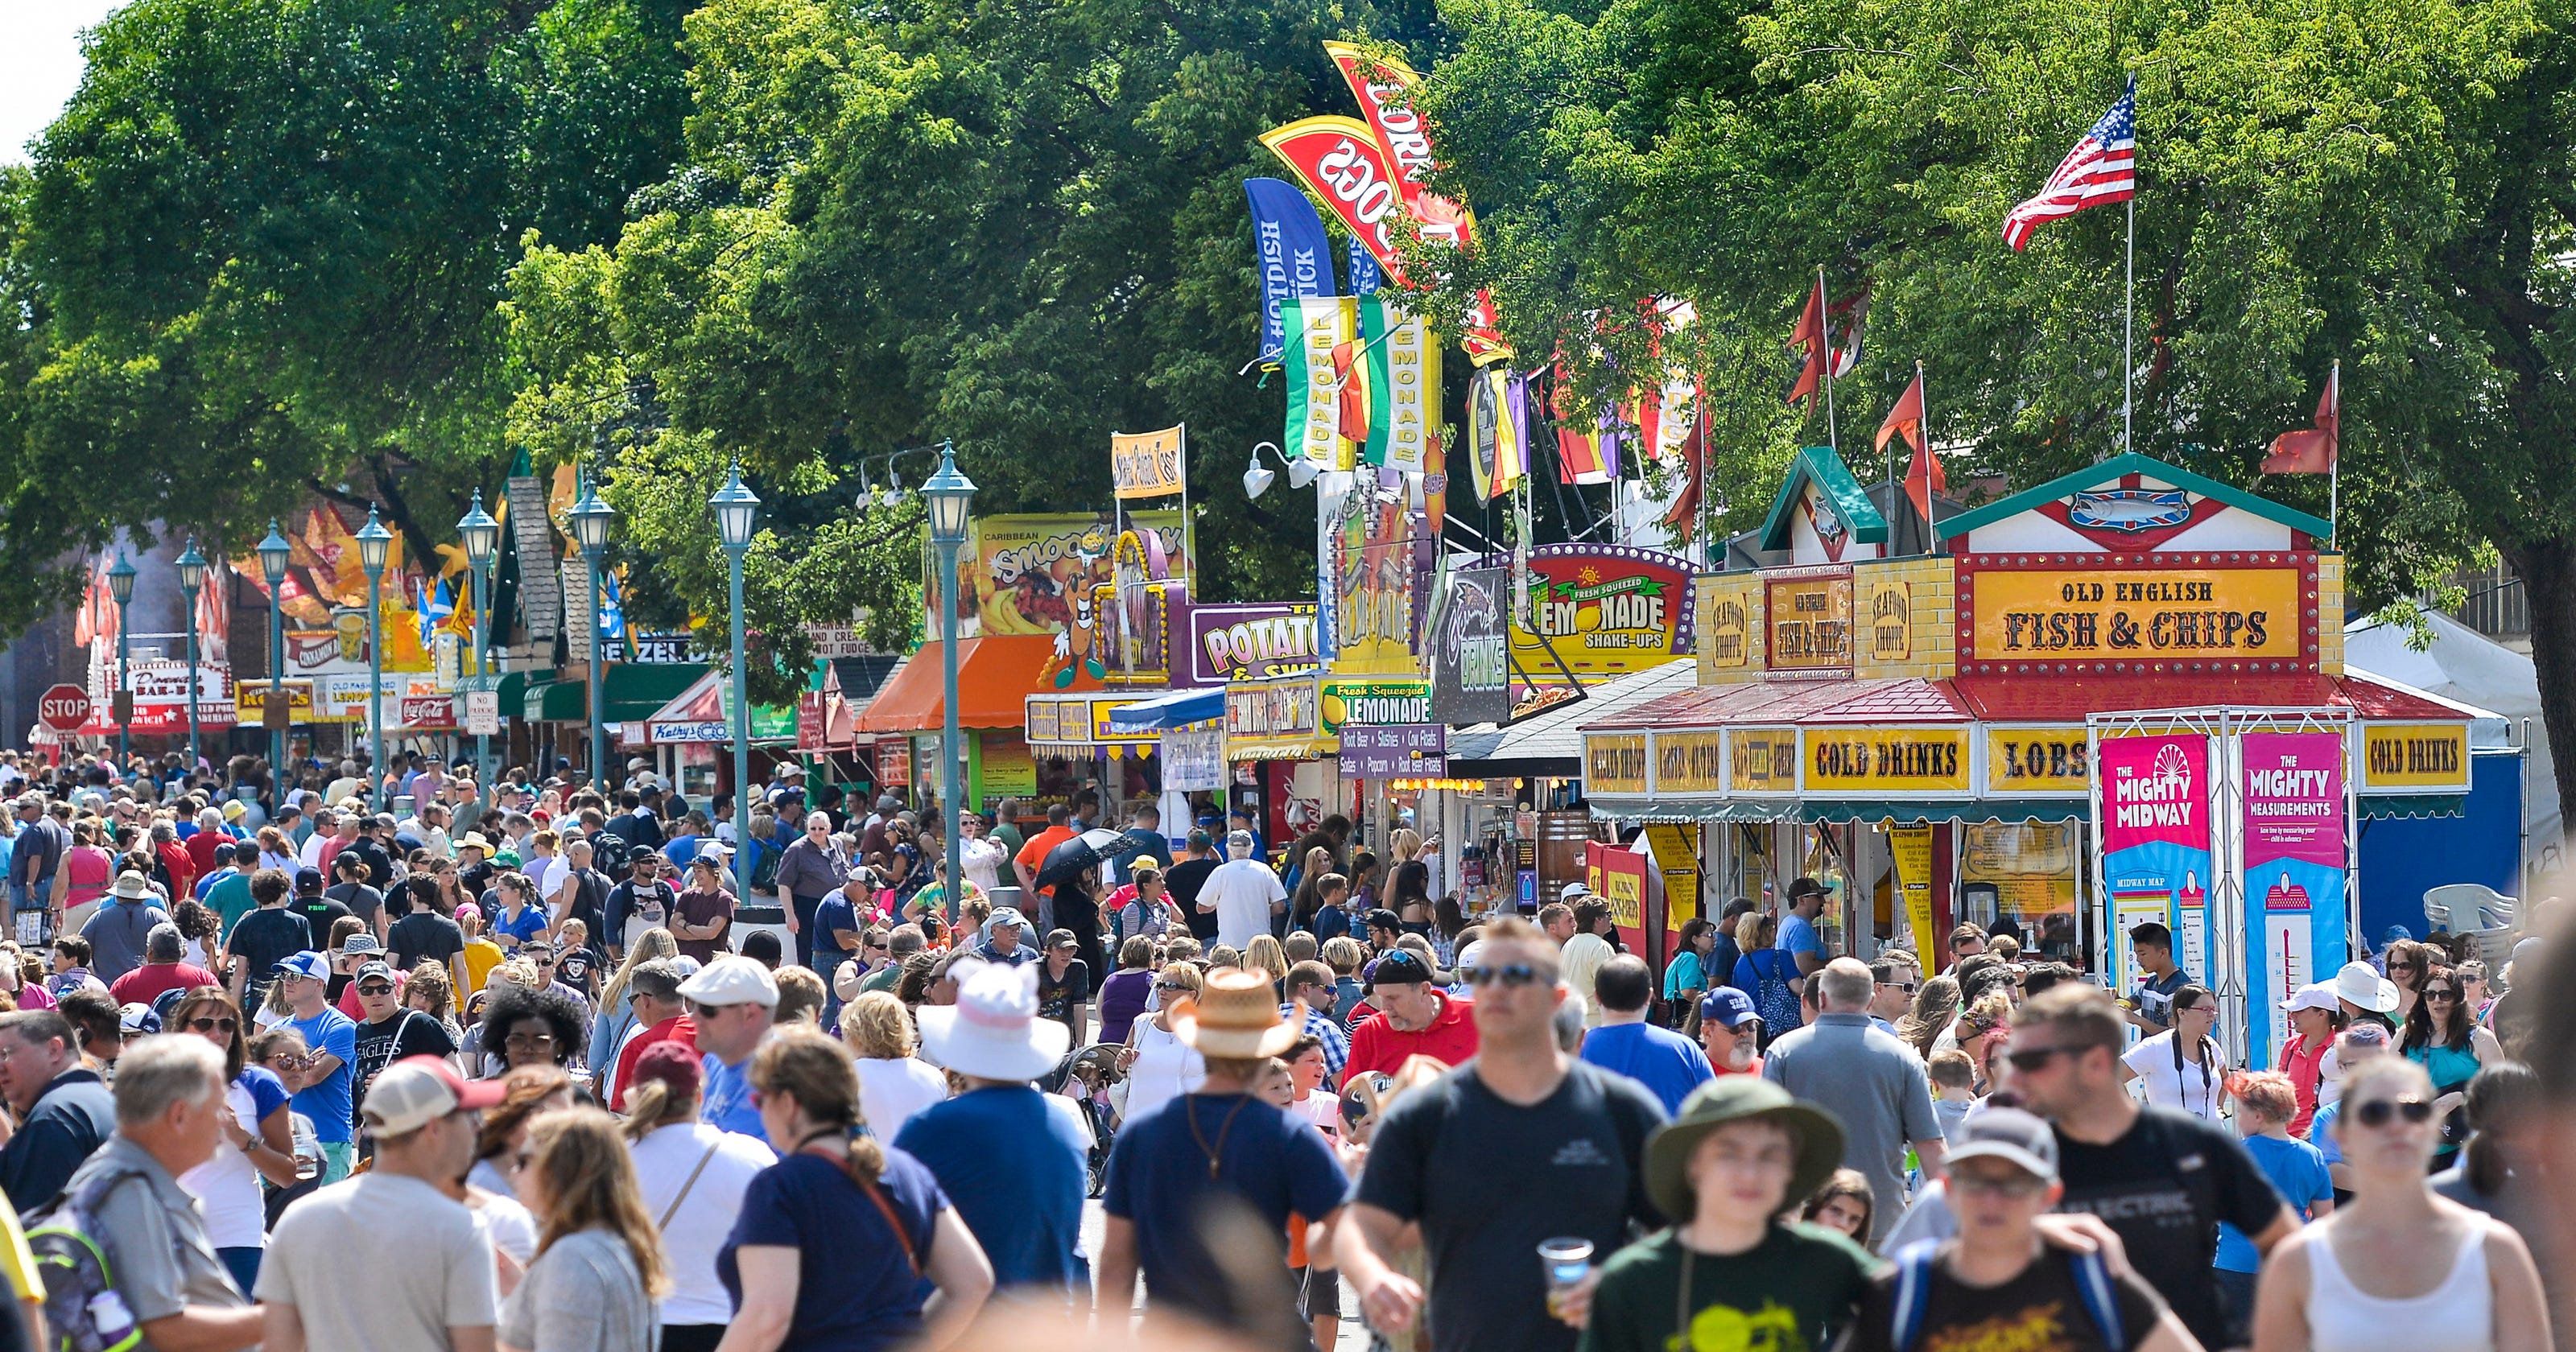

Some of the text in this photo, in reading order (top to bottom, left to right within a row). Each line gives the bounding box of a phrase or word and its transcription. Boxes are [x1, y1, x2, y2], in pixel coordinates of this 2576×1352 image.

[1294, 246, 1319, 298] TICK
[1308, 317, 1335, 460] LEMONADE
[1393, 311, 1418, 463] LEMONADE
[985, 532, 1038, 541] CARIBBEAN
[1575, 578, 1643, 600] FRESH SQUEEZED
[2062, 582, 2213, 603] OLD ENGLISH
[1713, 600, 1745, 634] SEAFOOD
[1872, 589, 1907, 625] SEAFOOD
[1585, 633, 1664, 649] SHAKE-UPS
[1778, 620, 1802, 657] FISH
[1875, 624, 1905, 652] SHOPPE
[2004, 610, 2268, 652] FISH & CHIPS
[840, 643, 870, 653] FUDGE
[1715, 634, 1742, 658] SHOPPE
[1461, 637, 1507, 692] DRINKS
[332, 681, 396, 690] OLD FASHNED
[1336, 684, 1426, 698] Fresh Squeezed
[43, 699, 89, 718] STOP
[477, 697, 489, 705] NO
[1346, 697, 1430, 723] LEMONADE
[654, 723, 696, 740] Kathy's
[1344, 729, 1437, 748] Root Beer Slushies Cow Floats
[1340, 759, 1356, 773] Sodas
[1367, 758, 1389, 778] Popcorn
[1398, 756, 1410, 773] Root
[1424, 756, 1442, 773] Floats
[1816, 740, 1871, 778] COLD
[1876, 740, 1958, 778] DRINKS
[2280, 755, 2297, 767] THE
[2370, 737, 2459, 775] COLD DRINKS
[2116, 766, 2133, 777] THE
[2116, 776, 2192, 802] MIGHTY
[2249, 769, 2330, 798] MIGHTY
[2116, 802, 2193, 828] MIDWAY
[2250, 802, 2332, 817] MEASUREMENTS
[2116, 877, 2165, 888] MIDWAY MAP
